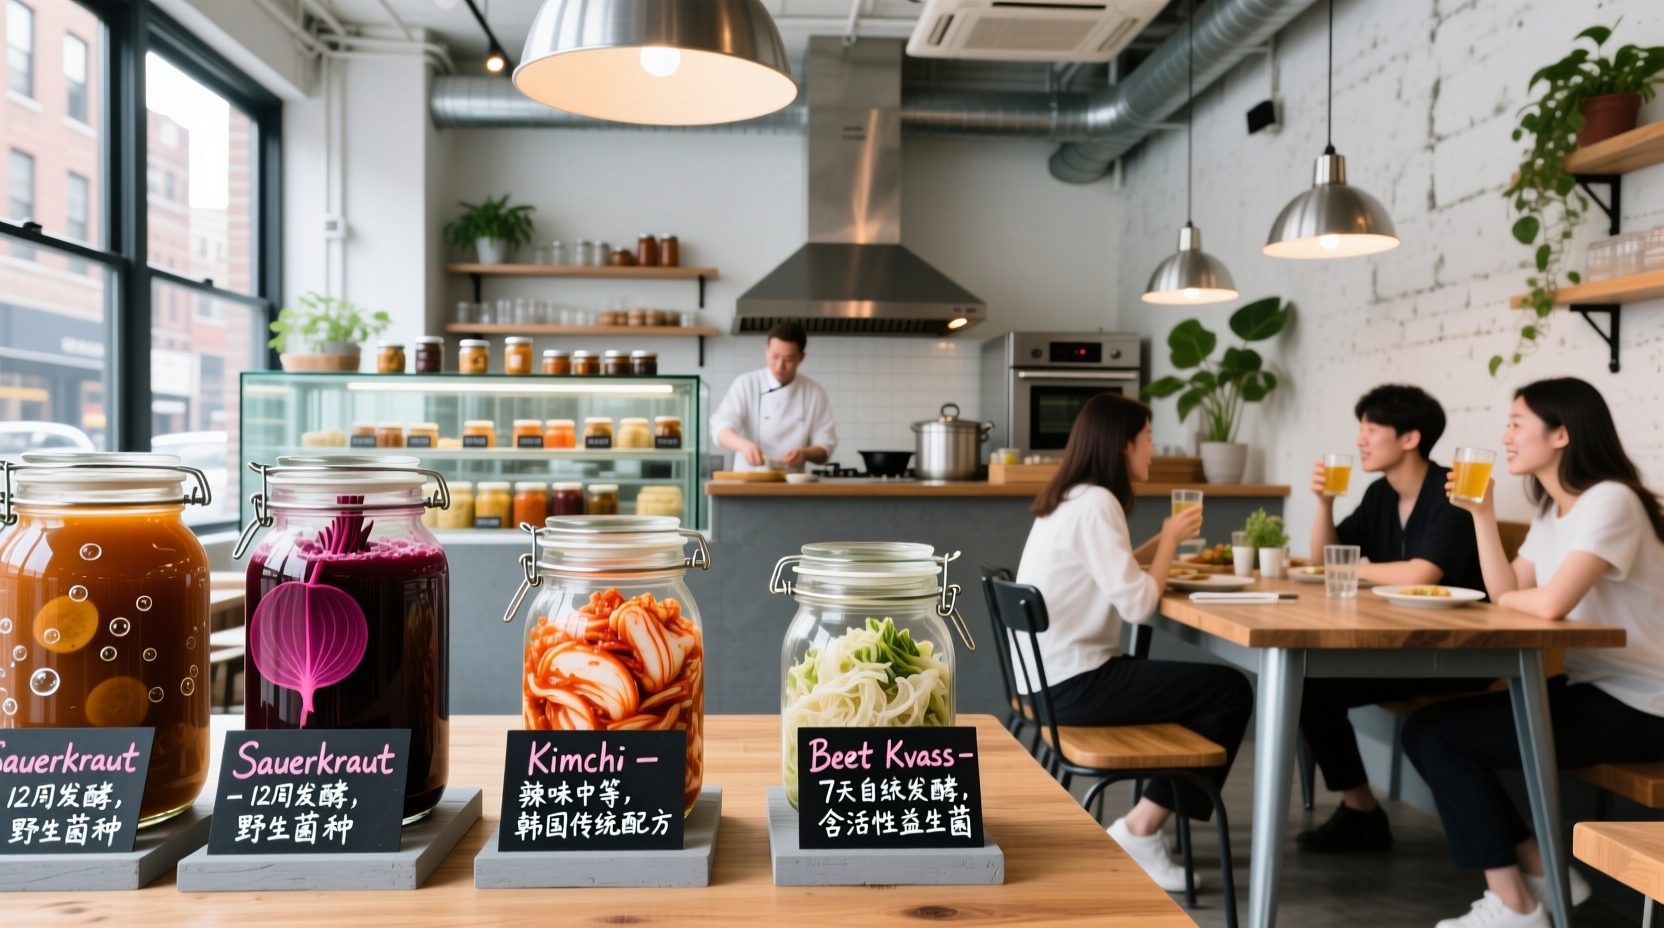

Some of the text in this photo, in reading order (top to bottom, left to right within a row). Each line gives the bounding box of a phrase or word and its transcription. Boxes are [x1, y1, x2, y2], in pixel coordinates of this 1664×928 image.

[0, 740, 140, 774] auerkraut
[232, 740, 396, 780] Sauerkraut
[527, 740, 626, 776] Kimchi
[808, 737, 874, 773] Beet
[7, 812, 122, 847] 野生菌种
[234, 810, 354, 846] 野生菌种
[514, 808, 673, 841] 韩国传统配方
